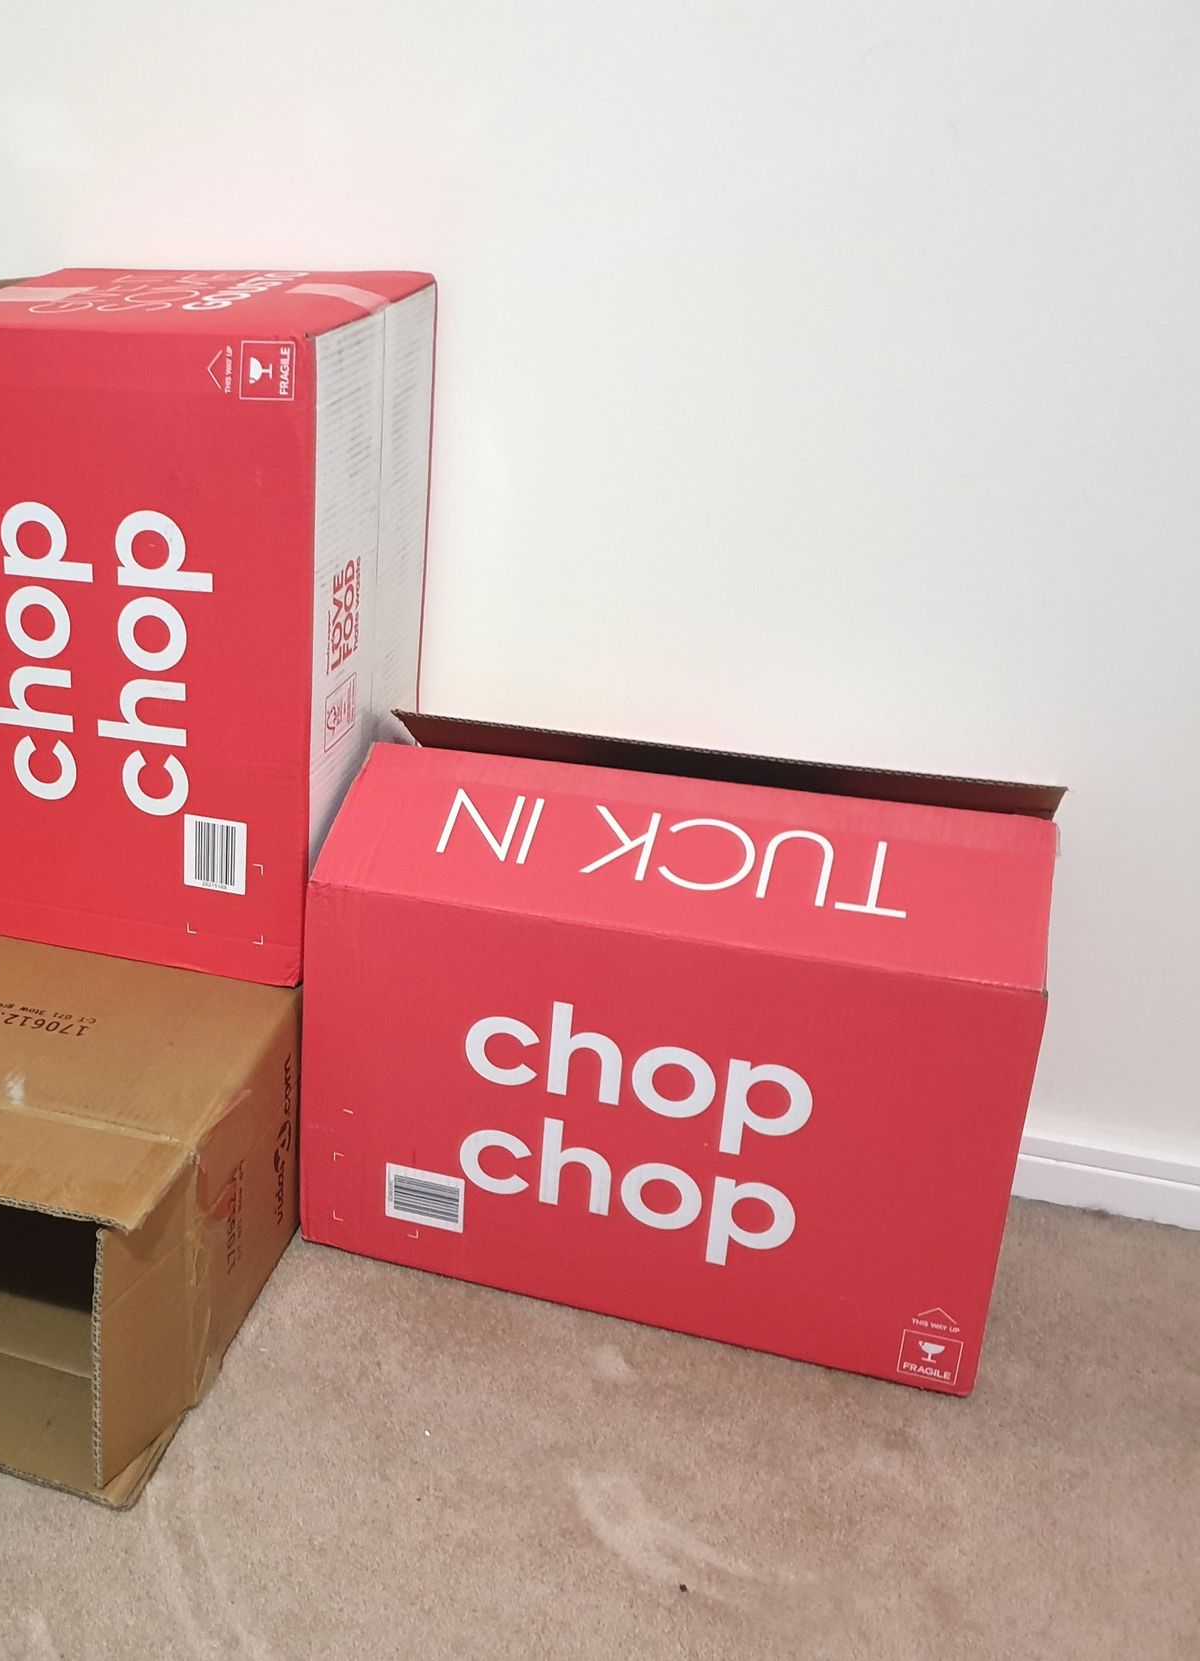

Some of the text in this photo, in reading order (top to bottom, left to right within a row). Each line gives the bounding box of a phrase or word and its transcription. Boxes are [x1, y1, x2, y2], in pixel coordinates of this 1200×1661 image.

[181, 271, 310, 311] GOUSTO
[279, 346, 291, 395] FRAGILE
[331, 569, 345, 672] LOVE
[342, 559, 356, 661] FOOD
[97, 509, 214, 816] chop
[435, 787, 907, 919] TUCK IN
[465, 1001, 814, 1156] chop
[459, 1117, 797, 1267] chop
[902, 1361, 951, 1380] FRAGILE
[912, 1317, 928, 1327] THIS
[930, 1322, 947, 1330] WAY
